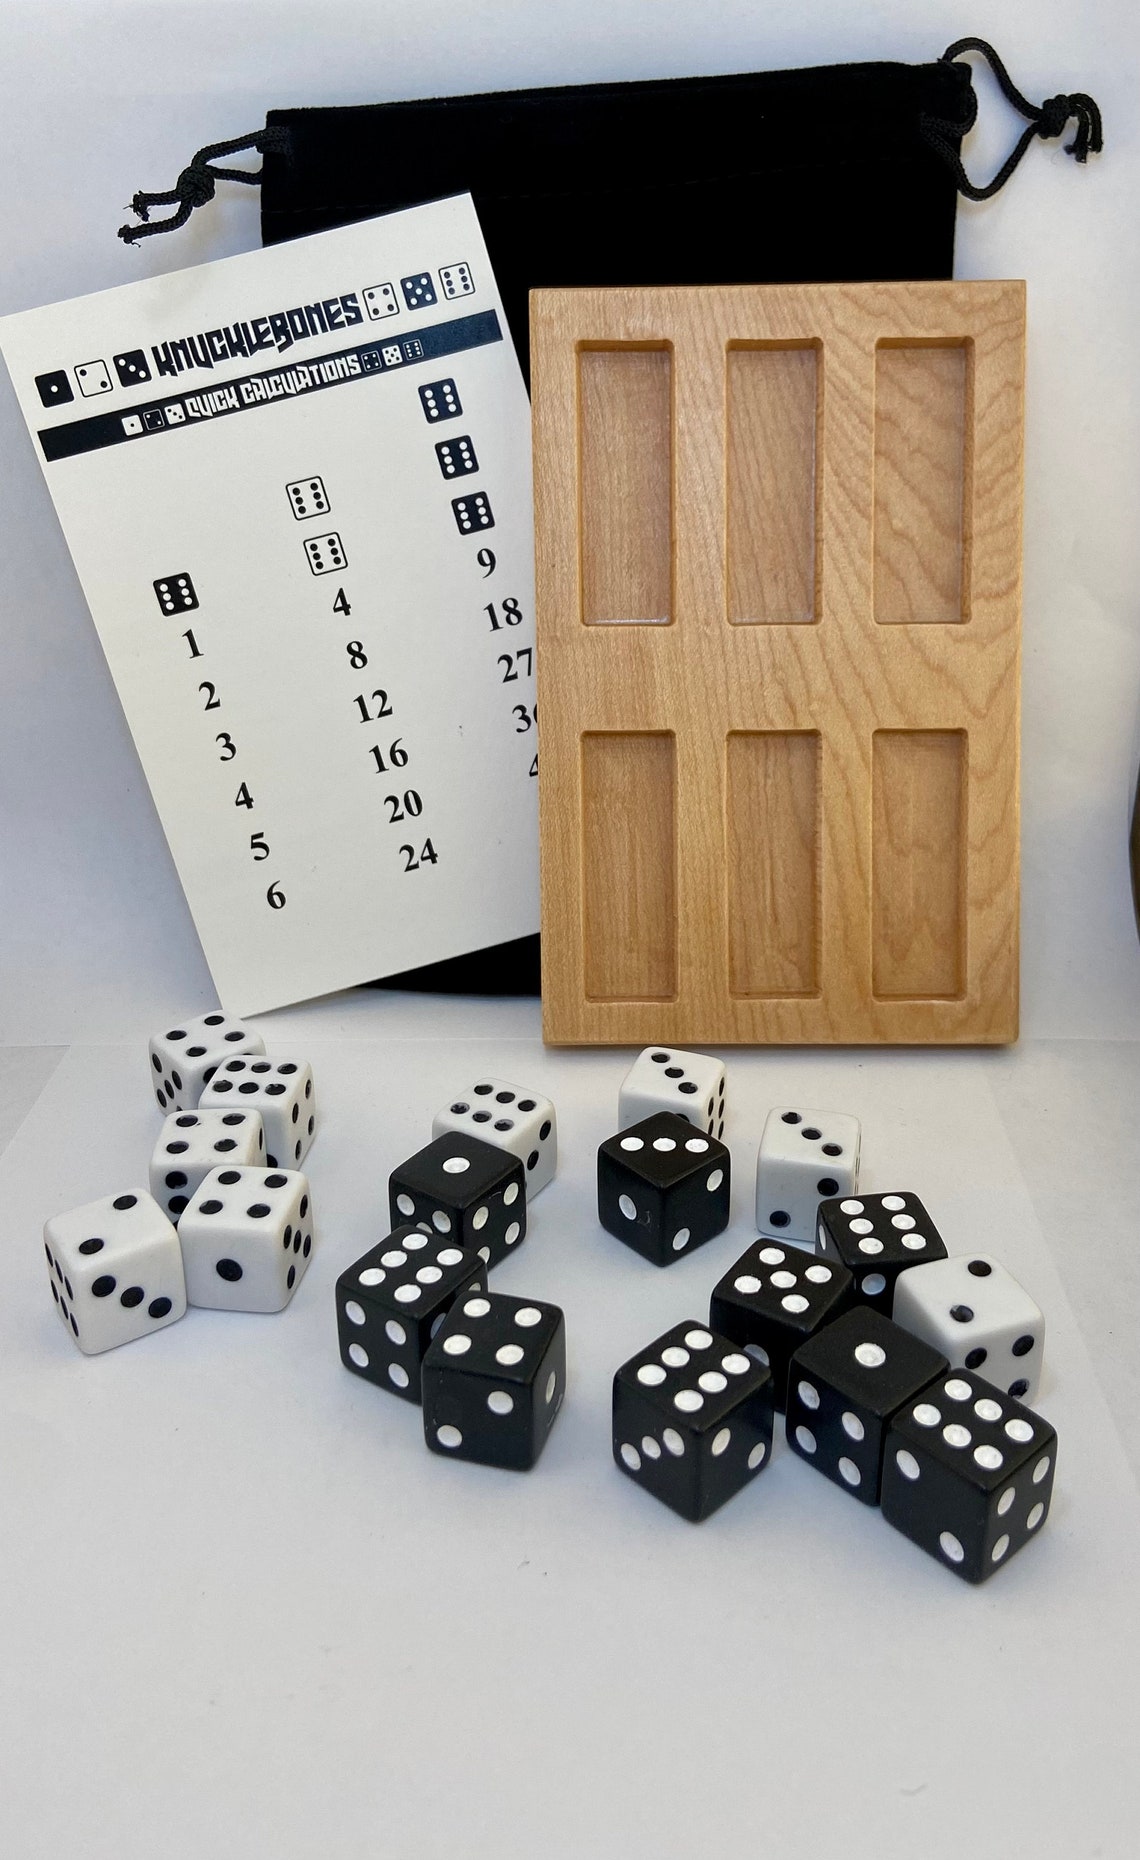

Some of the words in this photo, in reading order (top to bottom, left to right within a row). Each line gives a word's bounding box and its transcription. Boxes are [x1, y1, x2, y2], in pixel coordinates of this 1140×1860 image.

[151, 292, 364, 377] KNUCKLEBONES
[184, 385, 240, 418] QUICK
[239, 353, 362, 405] CALCULATIONS
[477, 548, 497, 578] 9
[333, 588, 352, 616] 4
[483, 598, 523, 631] 18
[183, 629, 204, 658] 1
[346, 641, 368, 669] 8
[497, 647, 533, 683] 27
[199, 682, 221, 710] 2
[353, 689, 393, 723] 12
[512, 704, 538, 733] 3
[215, 732, 237, 761] 3
[368, 738, 409, 774] 16
[234, 782, 254, 809] 4
[383, 790, 423, 823] 20
[250, 832, 270, 860] 5
[399, 838, 438, 872] 24
[266, 880, 286, 909] 6
